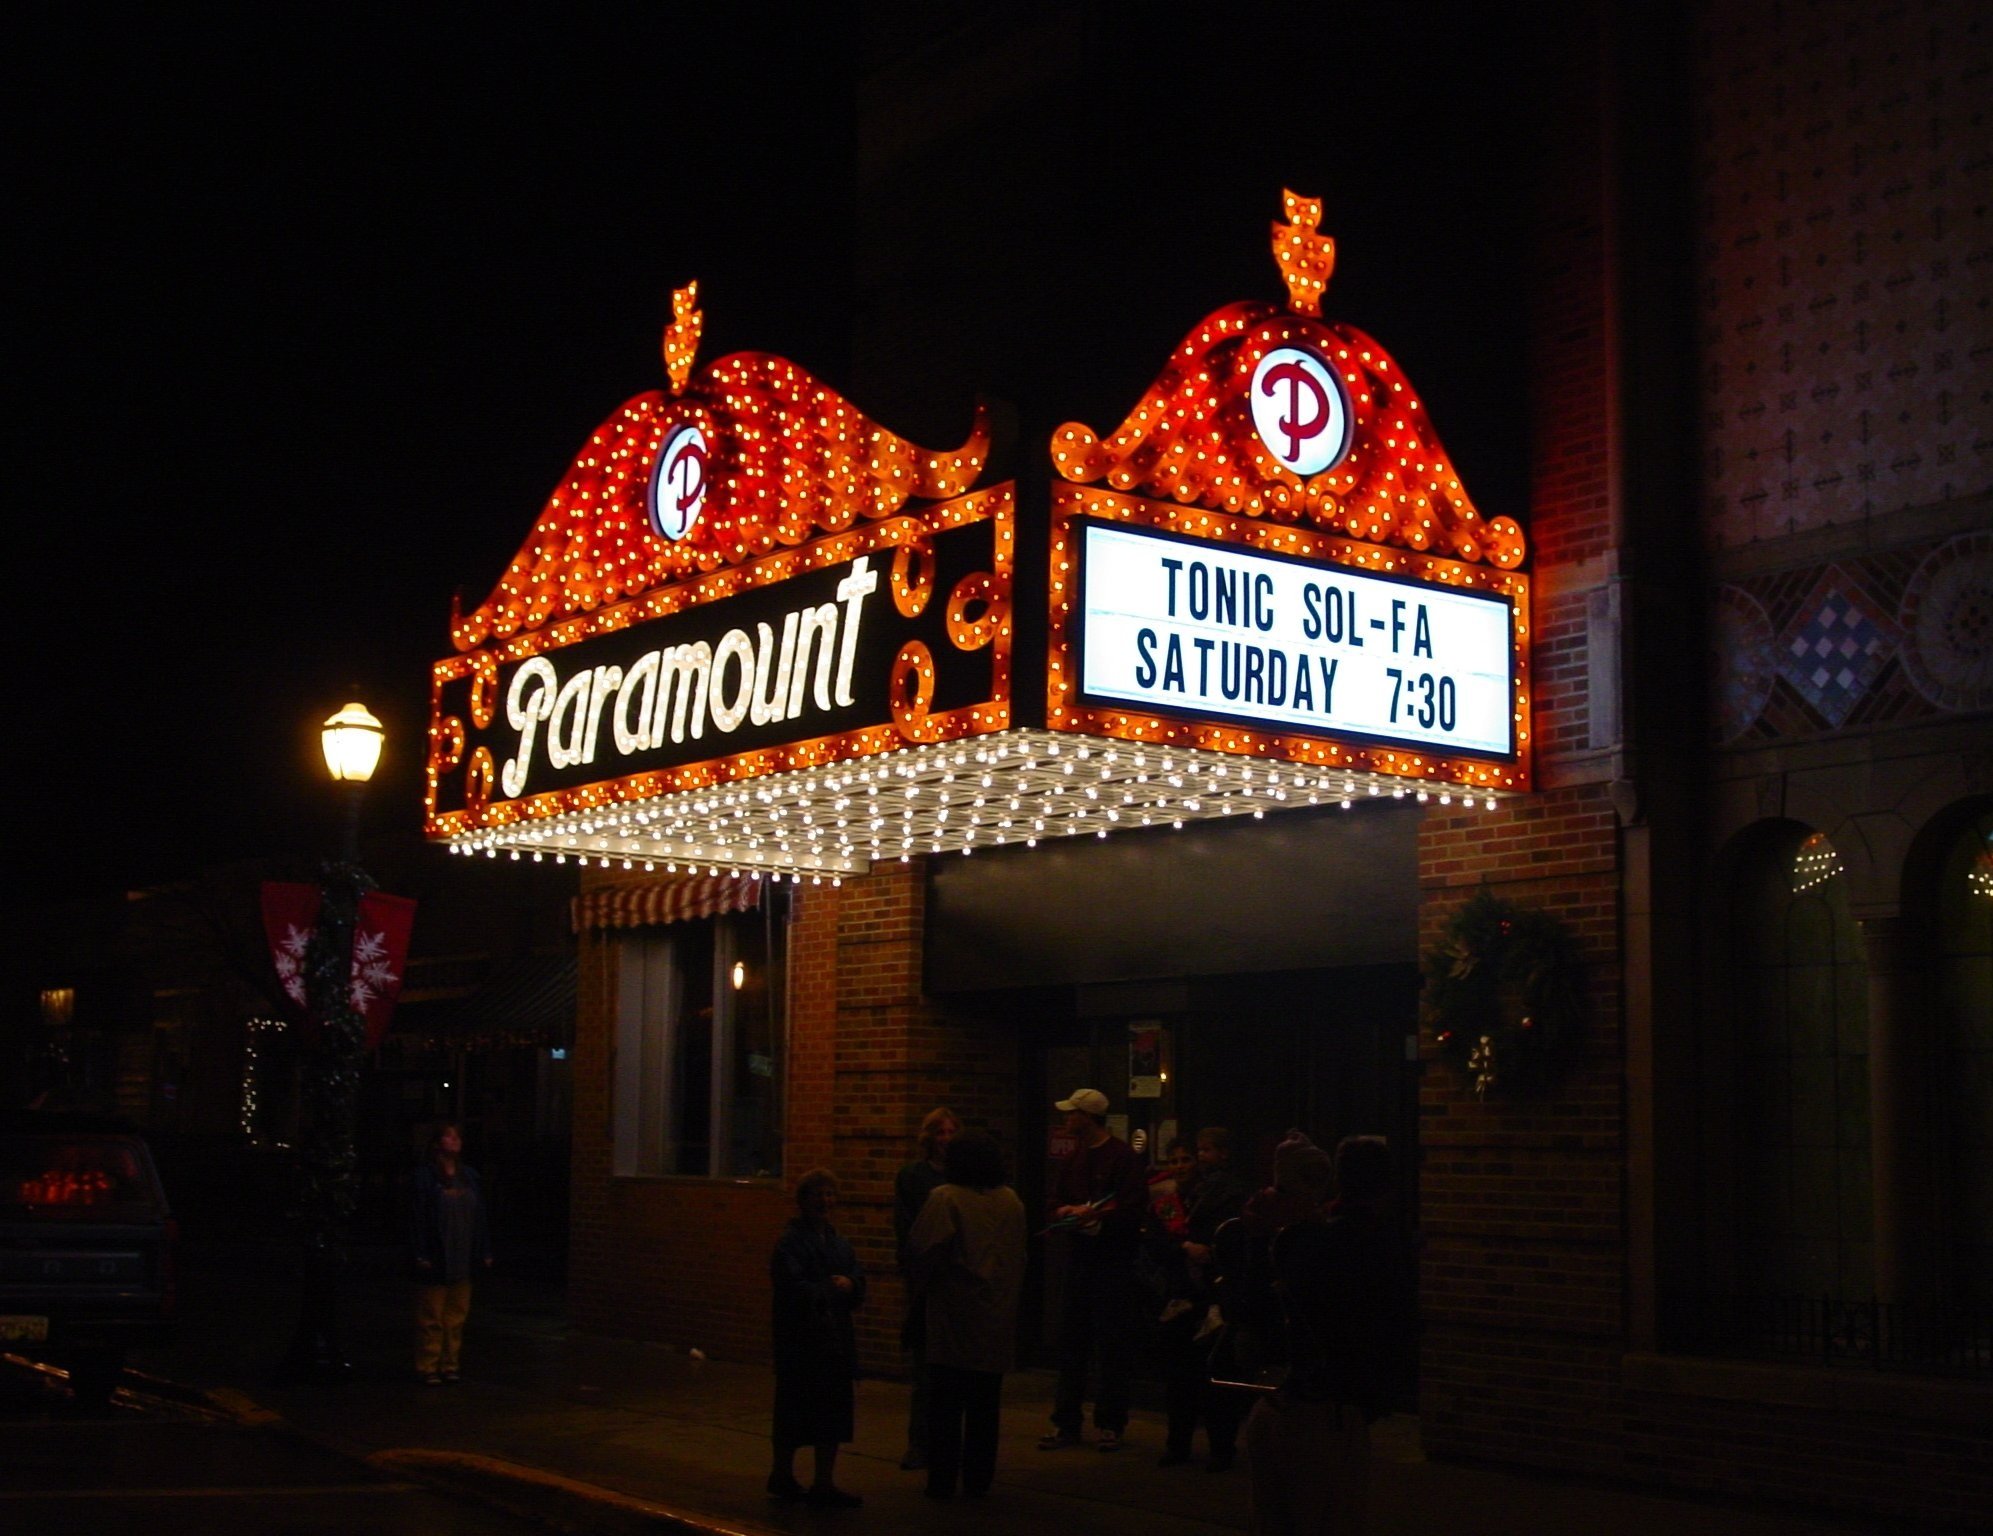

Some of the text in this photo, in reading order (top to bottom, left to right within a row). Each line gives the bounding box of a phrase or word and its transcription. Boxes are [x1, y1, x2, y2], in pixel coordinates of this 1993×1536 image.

[1261, 359, 1330, 463] P
[1161, 557, 1434, 660] TONIC SOL-FA
[501, 555, 878, 799] Paramount
[1135, 627, 1457, 732] SATURDAY 7:30
